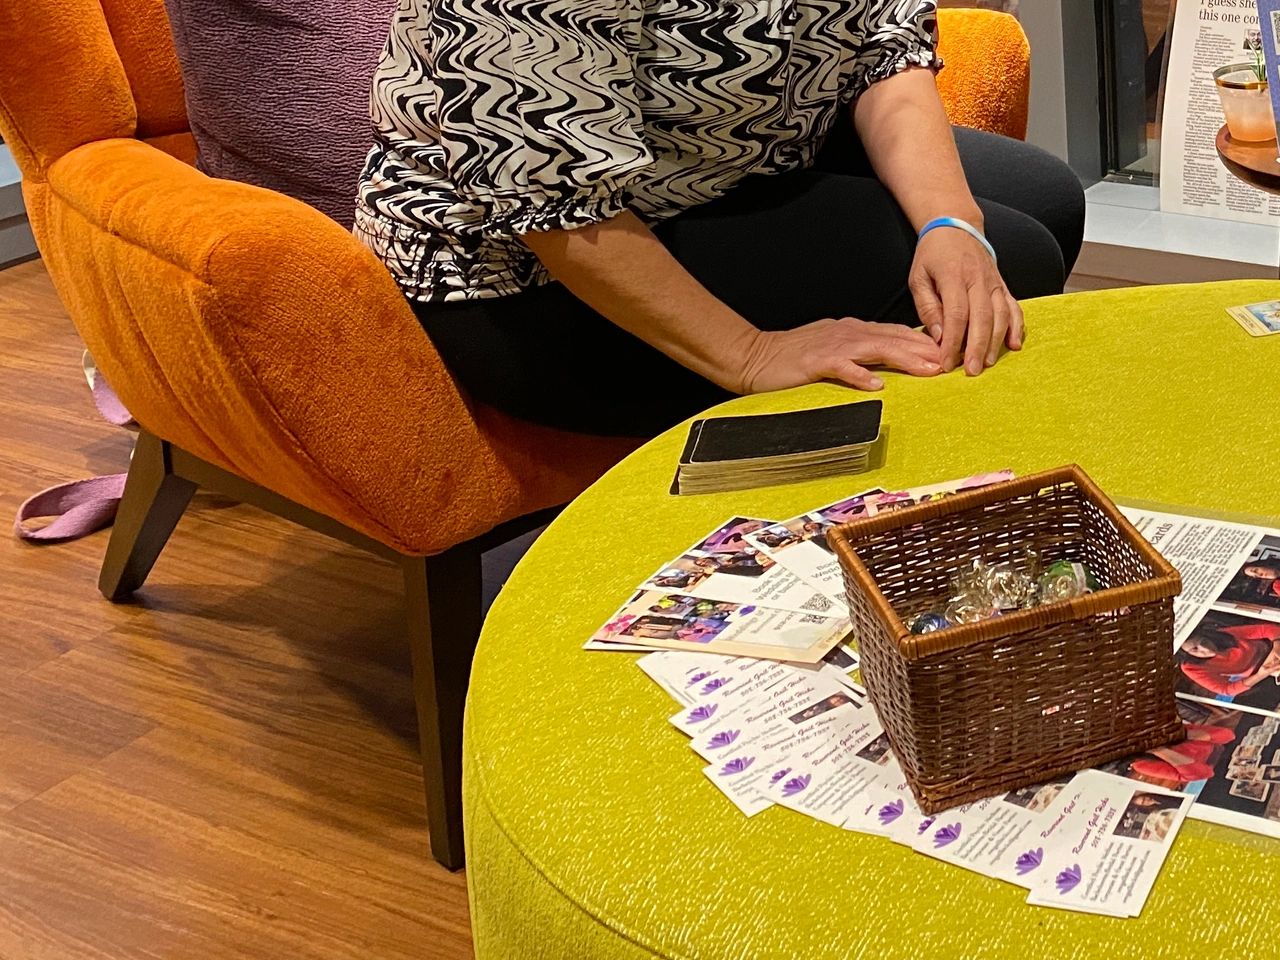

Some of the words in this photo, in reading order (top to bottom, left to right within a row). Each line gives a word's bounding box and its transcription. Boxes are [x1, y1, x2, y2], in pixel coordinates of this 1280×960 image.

[1199, 9, 1219, 20] this
[1221, 14, 1240, 23] one
[754, 669, 768, 680] Gail
[779, 696, 794, 707] Gail
[798, 725, 814, 735] Gail
[840, 734, 853, 746] Gail
[1088, 813, 1099, 826] Gail
